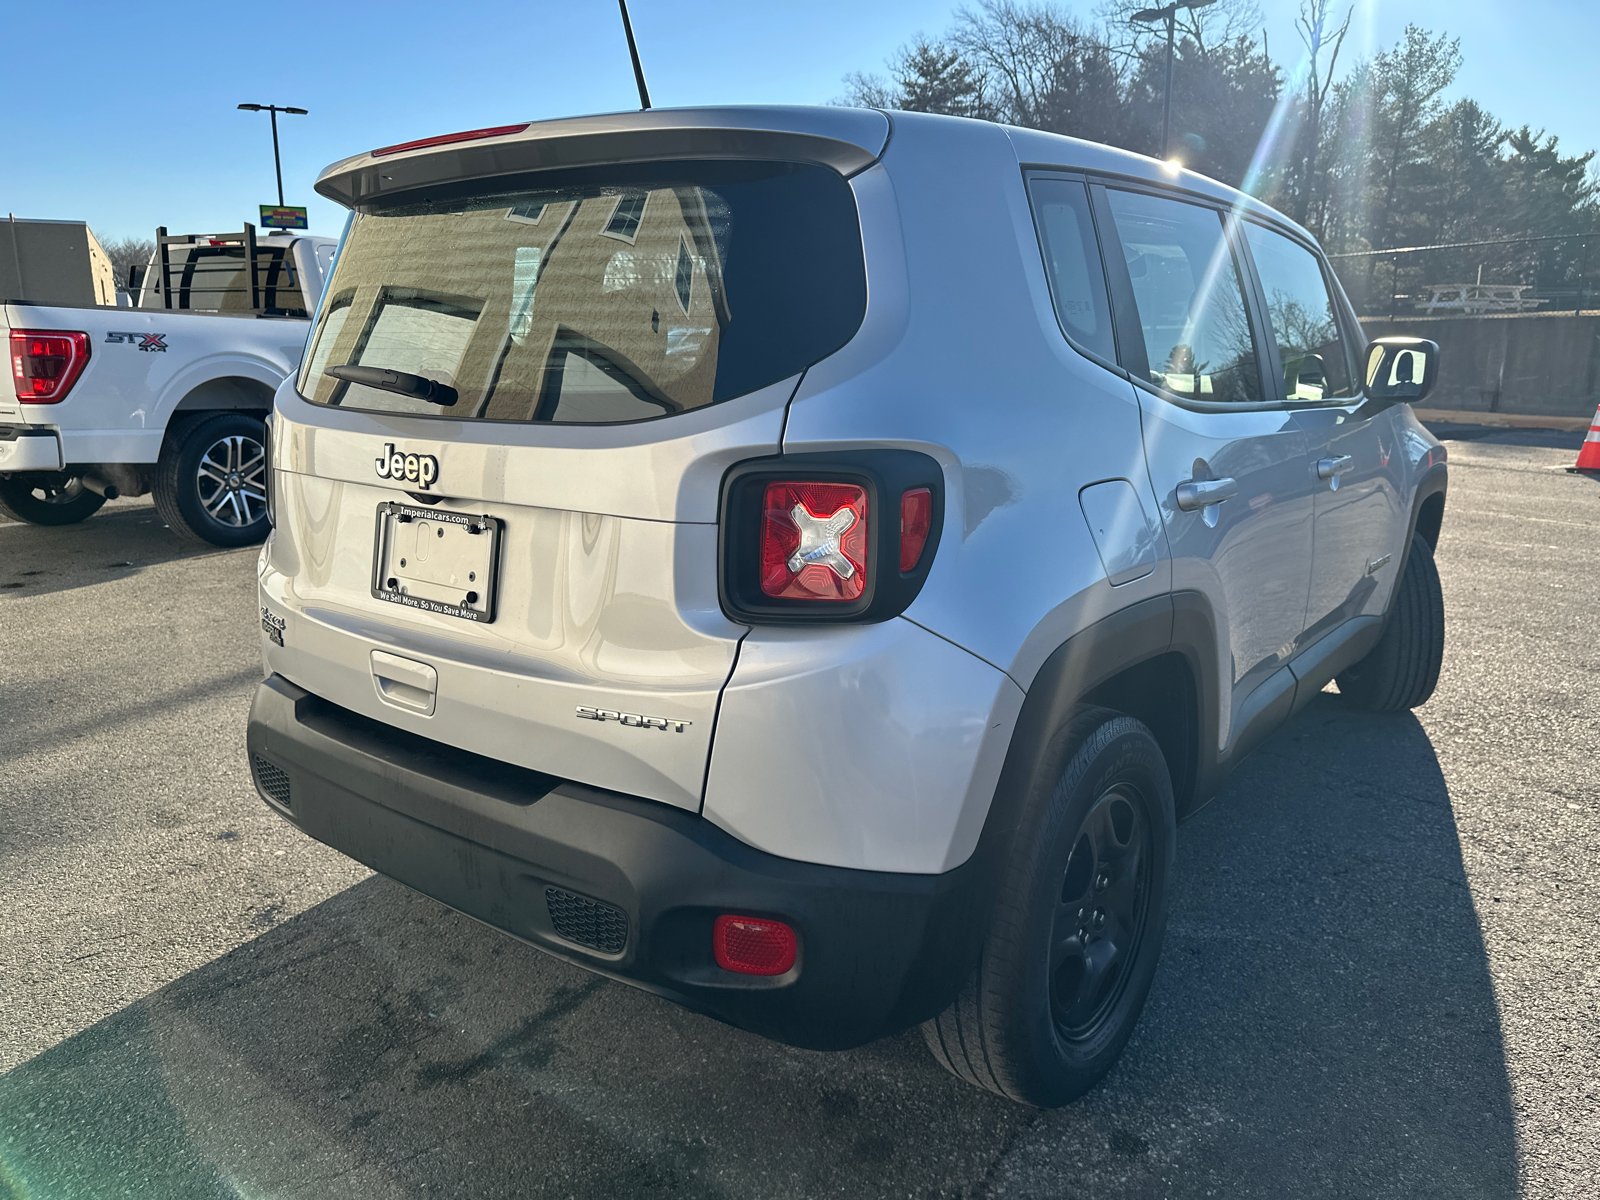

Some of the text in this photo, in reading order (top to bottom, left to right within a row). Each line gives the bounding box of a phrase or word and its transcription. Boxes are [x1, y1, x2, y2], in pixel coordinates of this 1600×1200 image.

[105, 331, 168, 347] STX
[375, 443, 439, 490] Jeep
[400, 506, 469, 525] Imperialcars.com
[380, 591, 478, 620] We Sell More, So You Save More
[575, 704, 693, 733] SPORT
